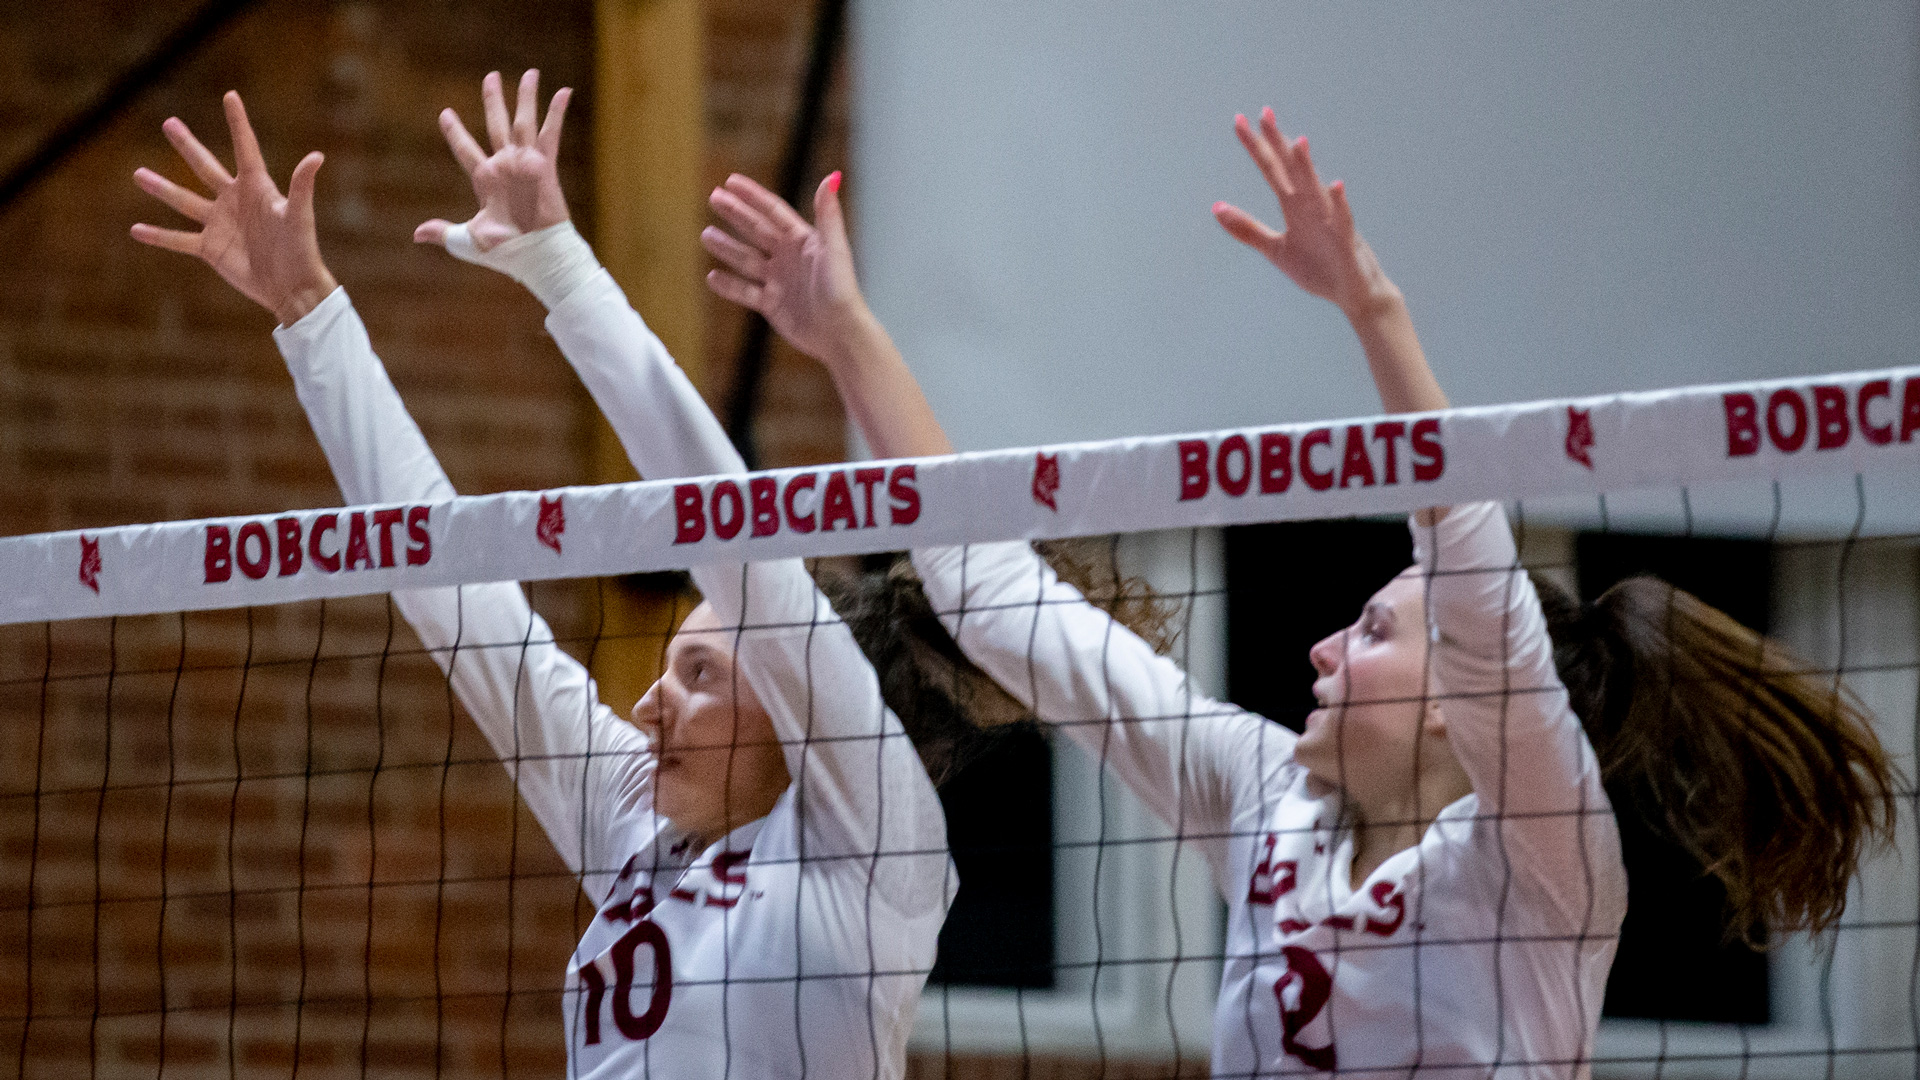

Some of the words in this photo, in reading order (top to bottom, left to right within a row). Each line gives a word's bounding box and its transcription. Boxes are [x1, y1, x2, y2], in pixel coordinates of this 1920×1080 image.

[1178, 418, 1445, 502] BOBCATS
[204, 505, 433, 584] BOBCATS
[674, 465, 921, 545] BOBCATS
[579, 919, 672, 1046] 10
[1274, 946, 1337, 1072] 2
